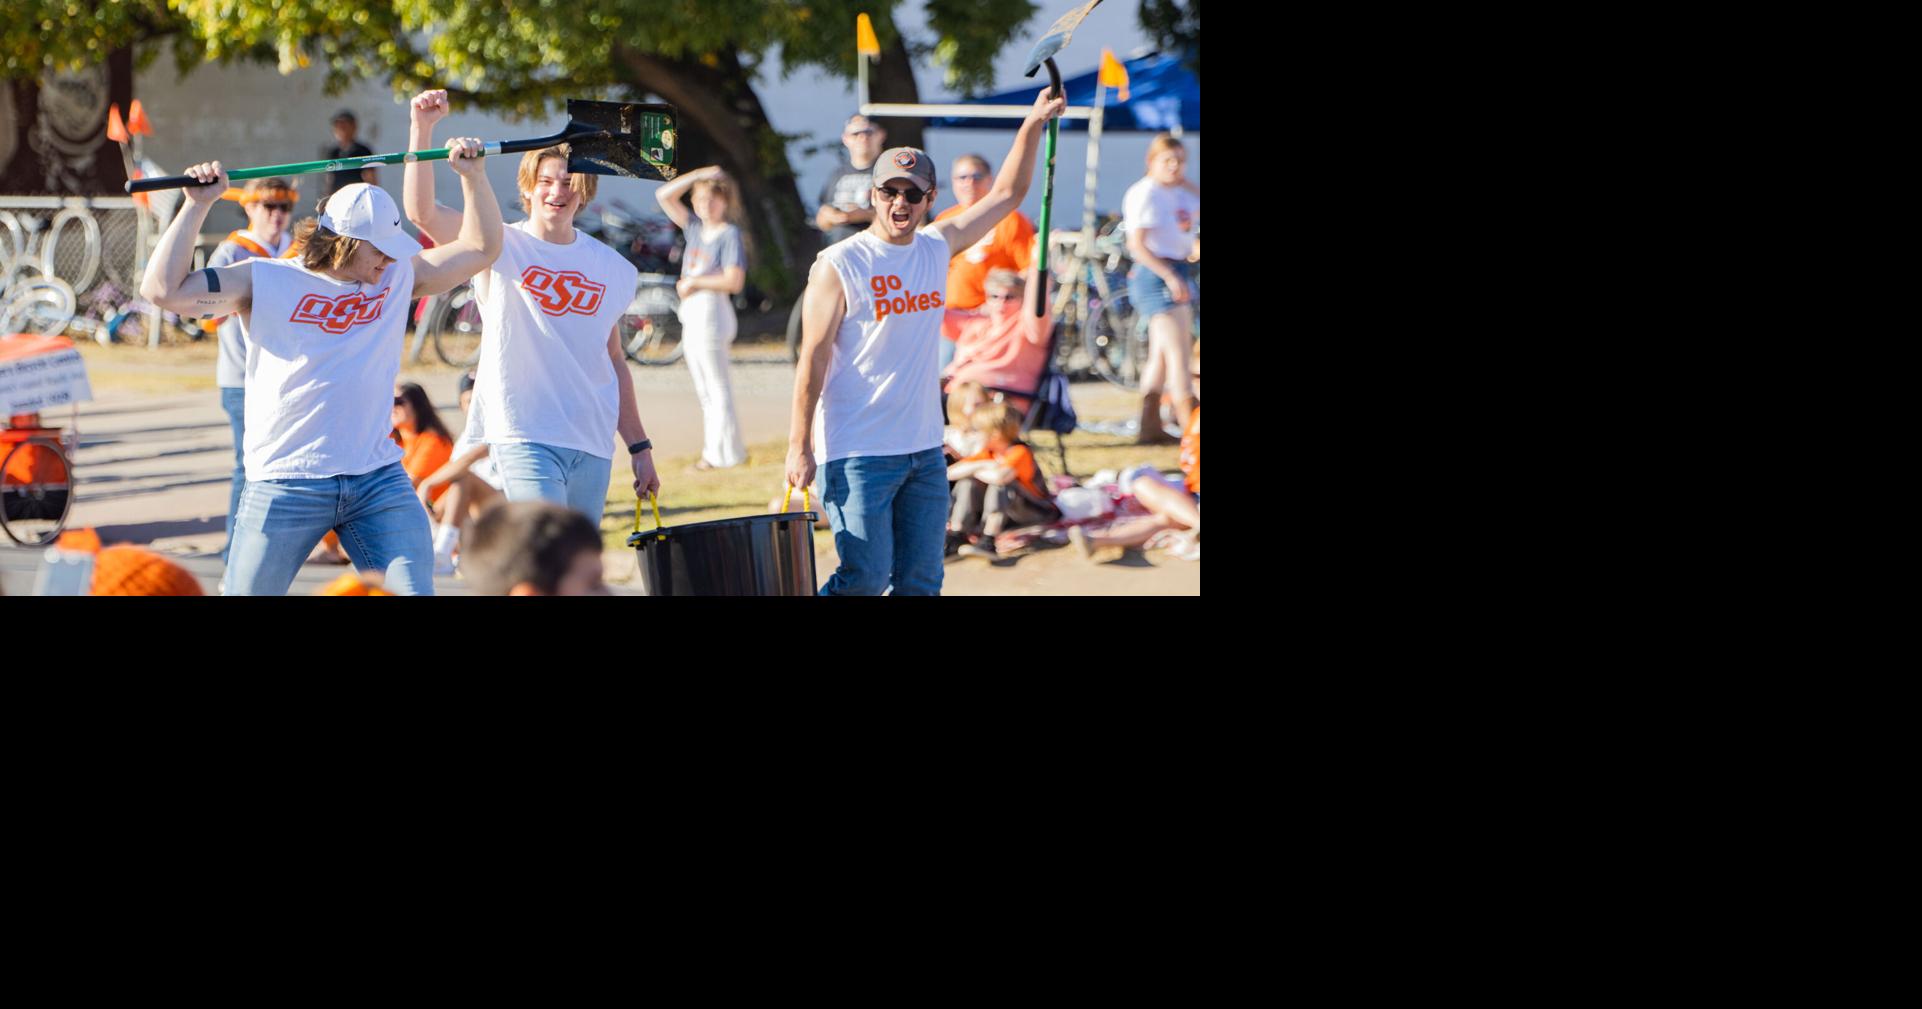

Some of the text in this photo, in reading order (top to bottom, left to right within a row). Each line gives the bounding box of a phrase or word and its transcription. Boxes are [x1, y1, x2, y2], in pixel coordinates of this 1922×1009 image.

[521, 265, 606, 316] OSU
[870, 274, 902, 298] go
[874, 289, 945, 322] pokes.
[289, 287, 391, 334] OSU
